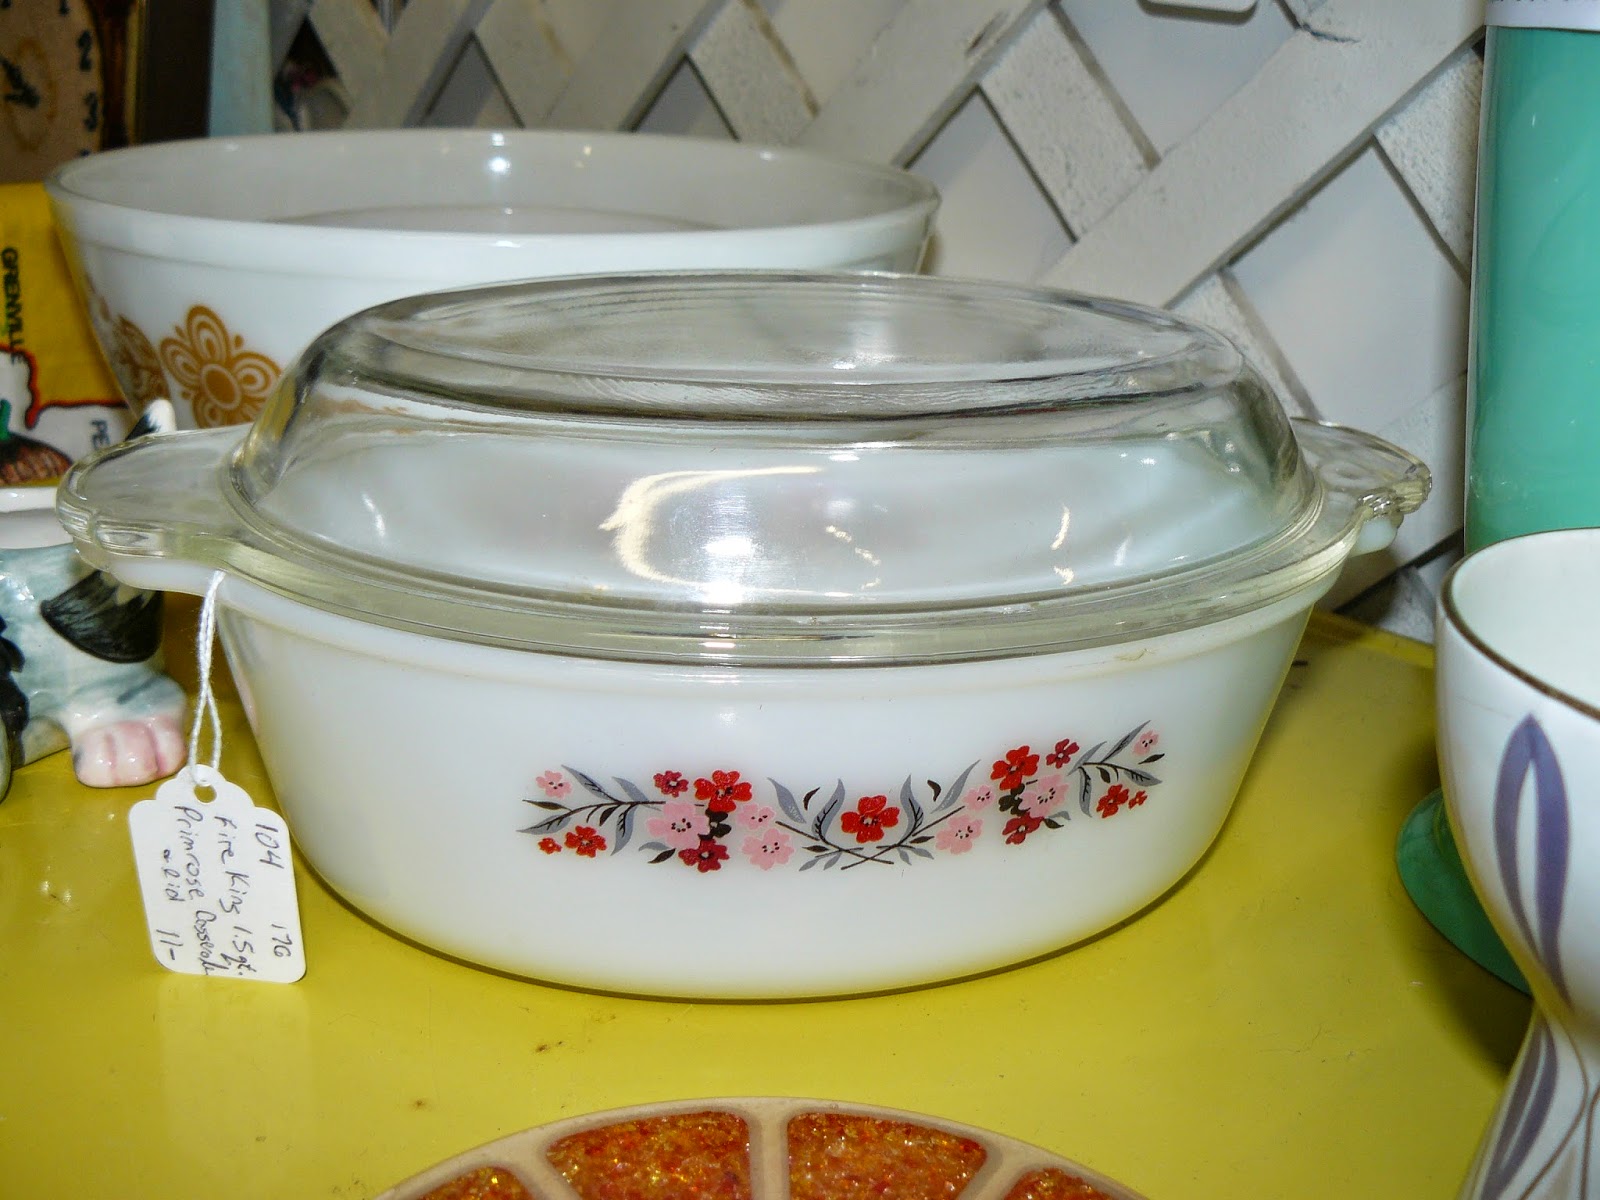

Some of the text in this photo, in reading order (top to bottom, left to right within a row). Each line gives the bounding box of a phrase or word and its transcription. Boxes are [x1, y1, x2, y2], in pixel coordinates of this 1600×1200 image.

[174, 805, 205, 900] Primrose
[214, 816, 237, 864] Fire
[255, 823, 285, 869] 104
[219, 870, 250, 914] King
